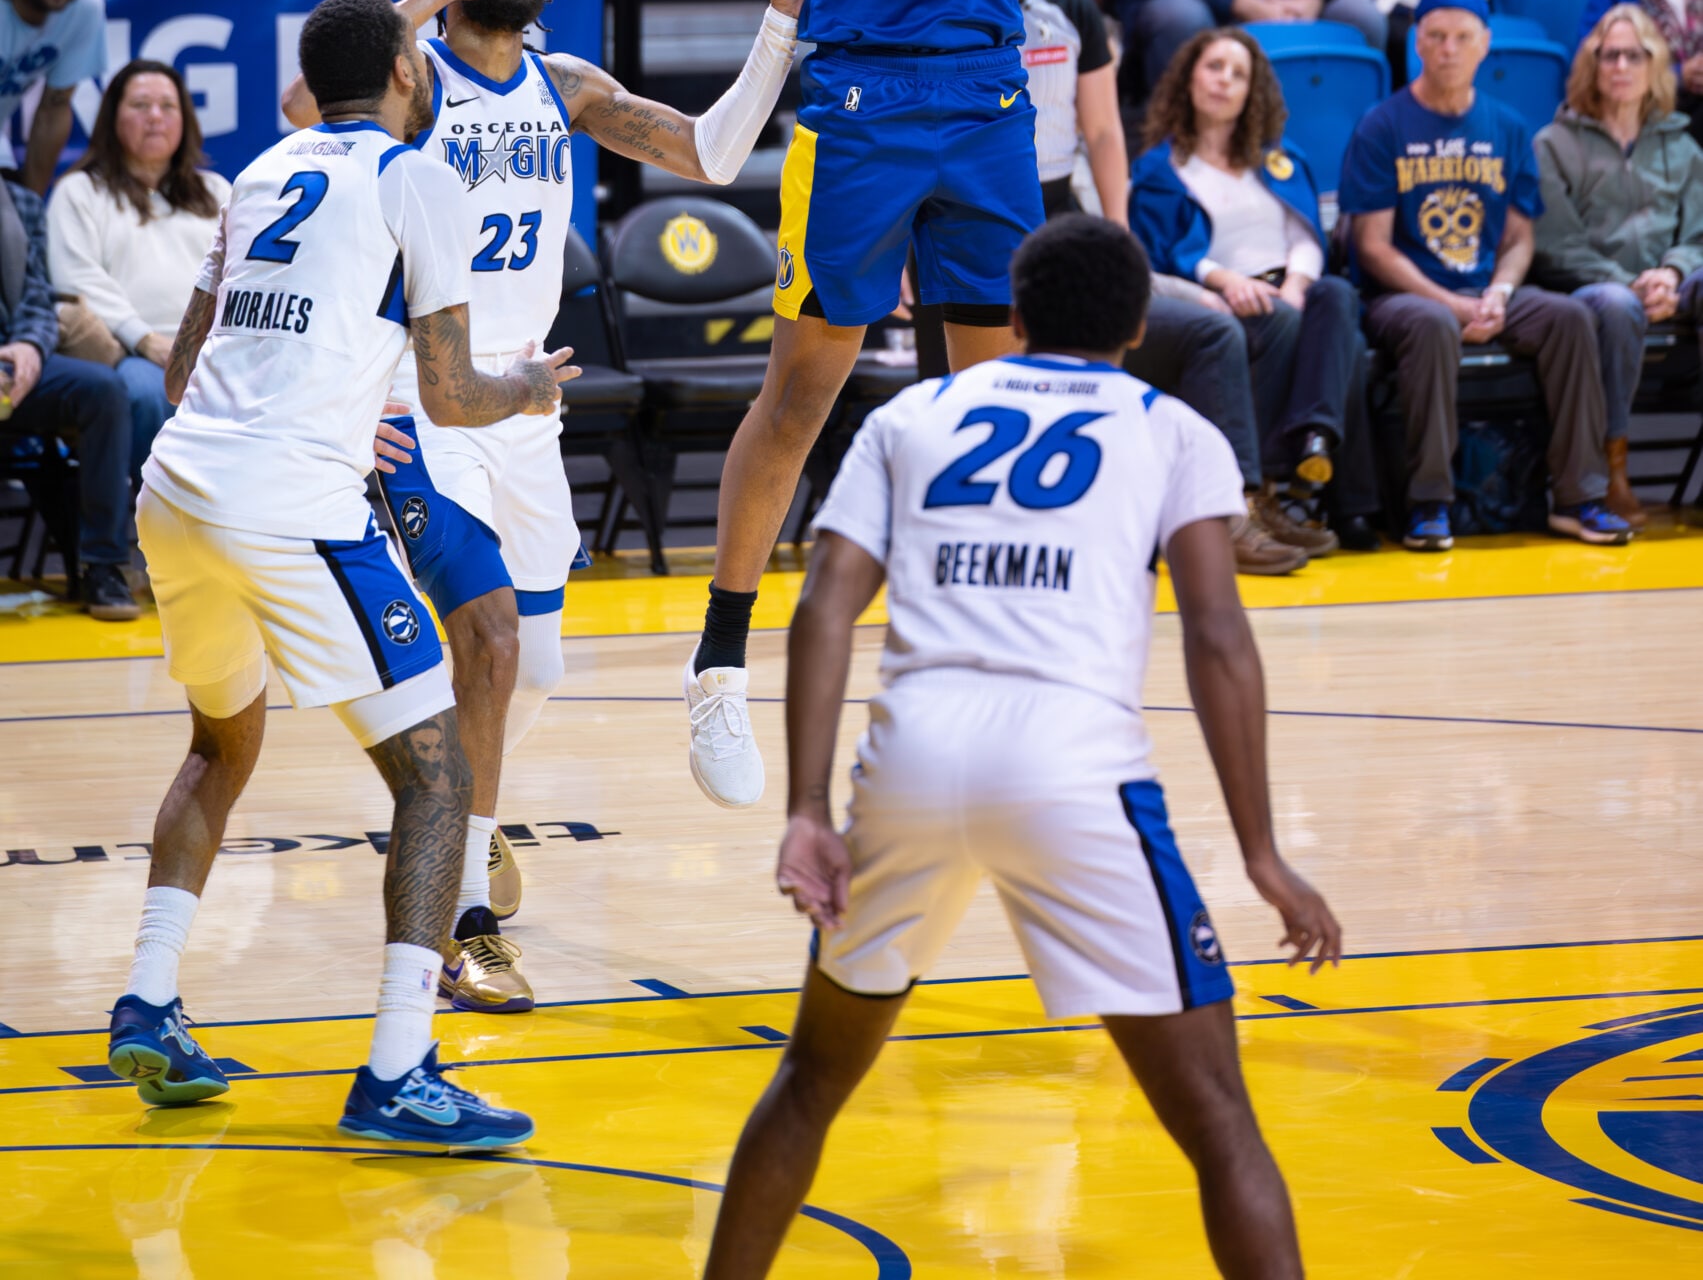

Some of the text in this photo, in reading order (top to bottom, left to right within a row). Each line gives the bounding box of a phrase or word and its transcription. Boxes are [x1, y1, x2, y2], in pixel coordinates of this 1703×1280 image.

[451, 120, 563, 135] OSCEOLA
[245, 170, 329, 264] 2
[471, 210, 542, 272] 23
[221, 290, 314, 335] MORALES
[923, 405, 1115, 510] 26
[934, 541, 1074, 592] BEEKMAN
